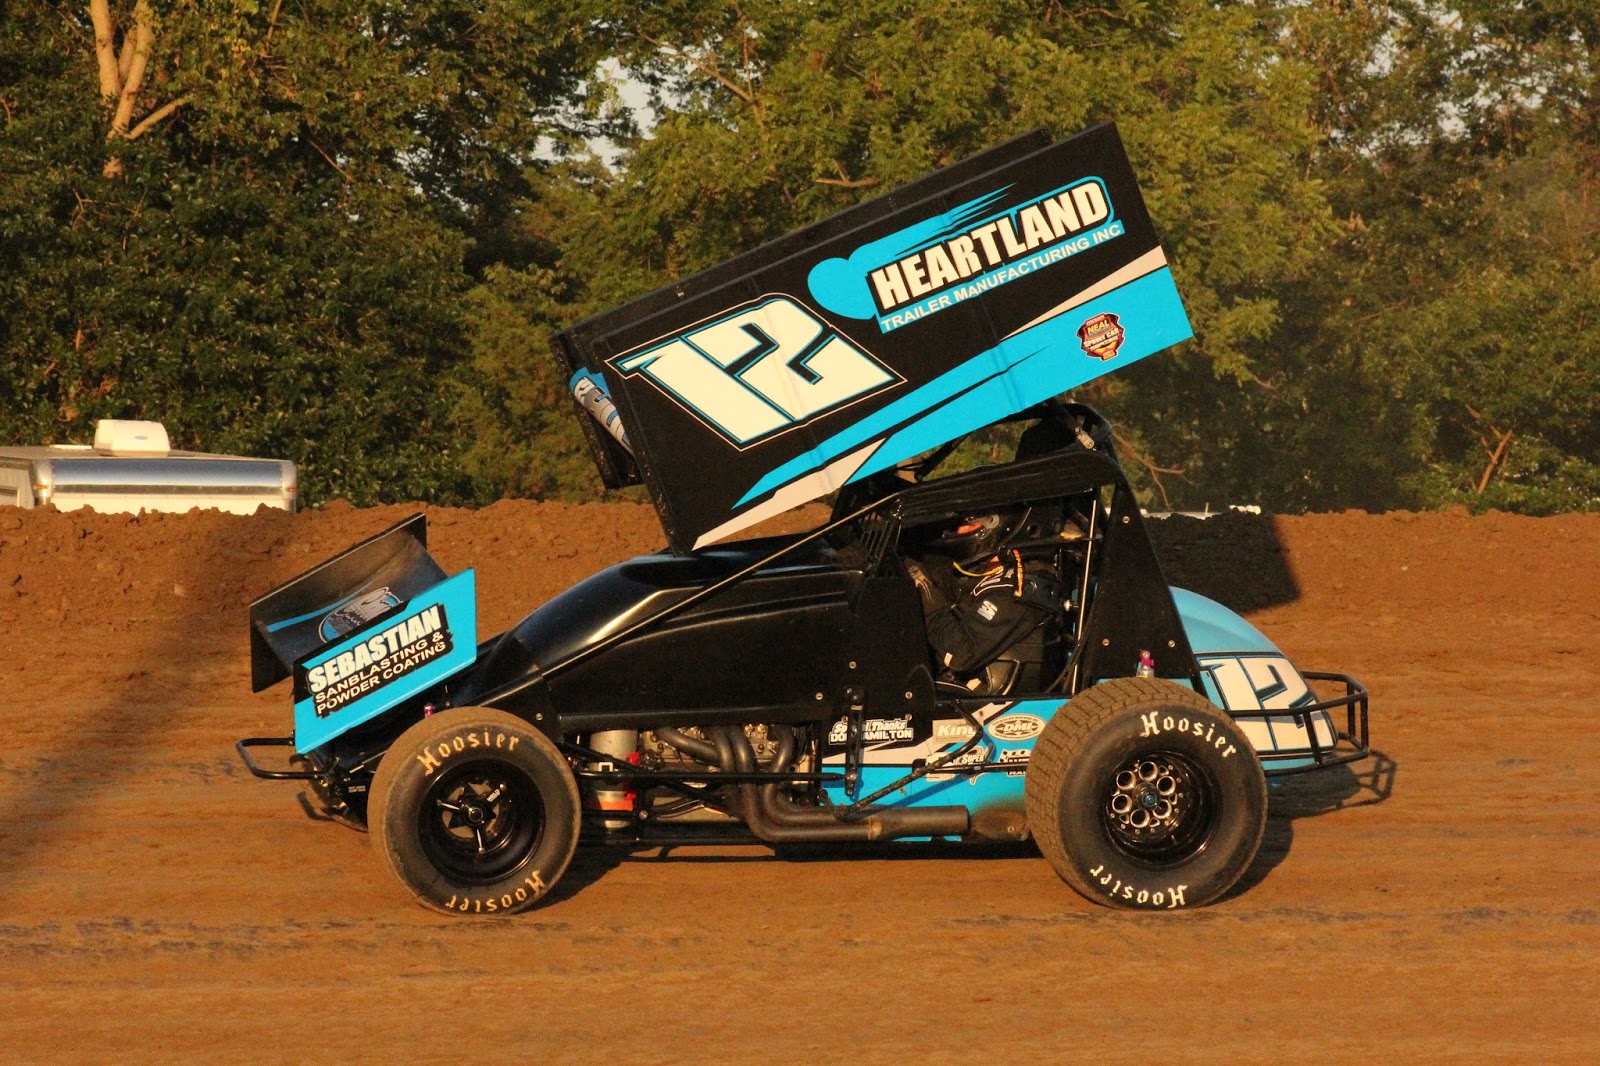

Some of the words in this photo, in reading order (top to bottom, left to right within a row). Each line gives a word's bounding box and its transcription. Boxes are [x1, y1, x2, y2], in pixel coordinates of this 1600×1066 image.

[871, 182, 1109, 310] HEARTLAND
[881, 295, 953, 332] TRAILER
[953, 237, 1090, 303] MANUFACTURING
[1094, 224, 1121, 245] INC
[1087, 320, 1109, 334] NEAL
[1107, 327, 1120, 338] CAR
[617, 298, 894, 442] 12
[308, 606, 441, 693] SEBASTIAN
[315, 638, 429, 703] SANBLASTING
[432, 631, 443, 643] &
[317, 676, 380, 714] POWDER
[382, 641, 446, 680] COATING
[1199, 656, 1336, 749] 12
[864, 729, 912, 741] AMILTON
[871, 720, 906, 732] Thanks
[1003, 722, 1033, 732] DMI
[1140, 711, 1236, 758] Hoosier
[417, 731, 519, 776] Hoosier
[445, 870, 546, 912] Hoosier
[1090, 865, 1188, 909] Hoosier
